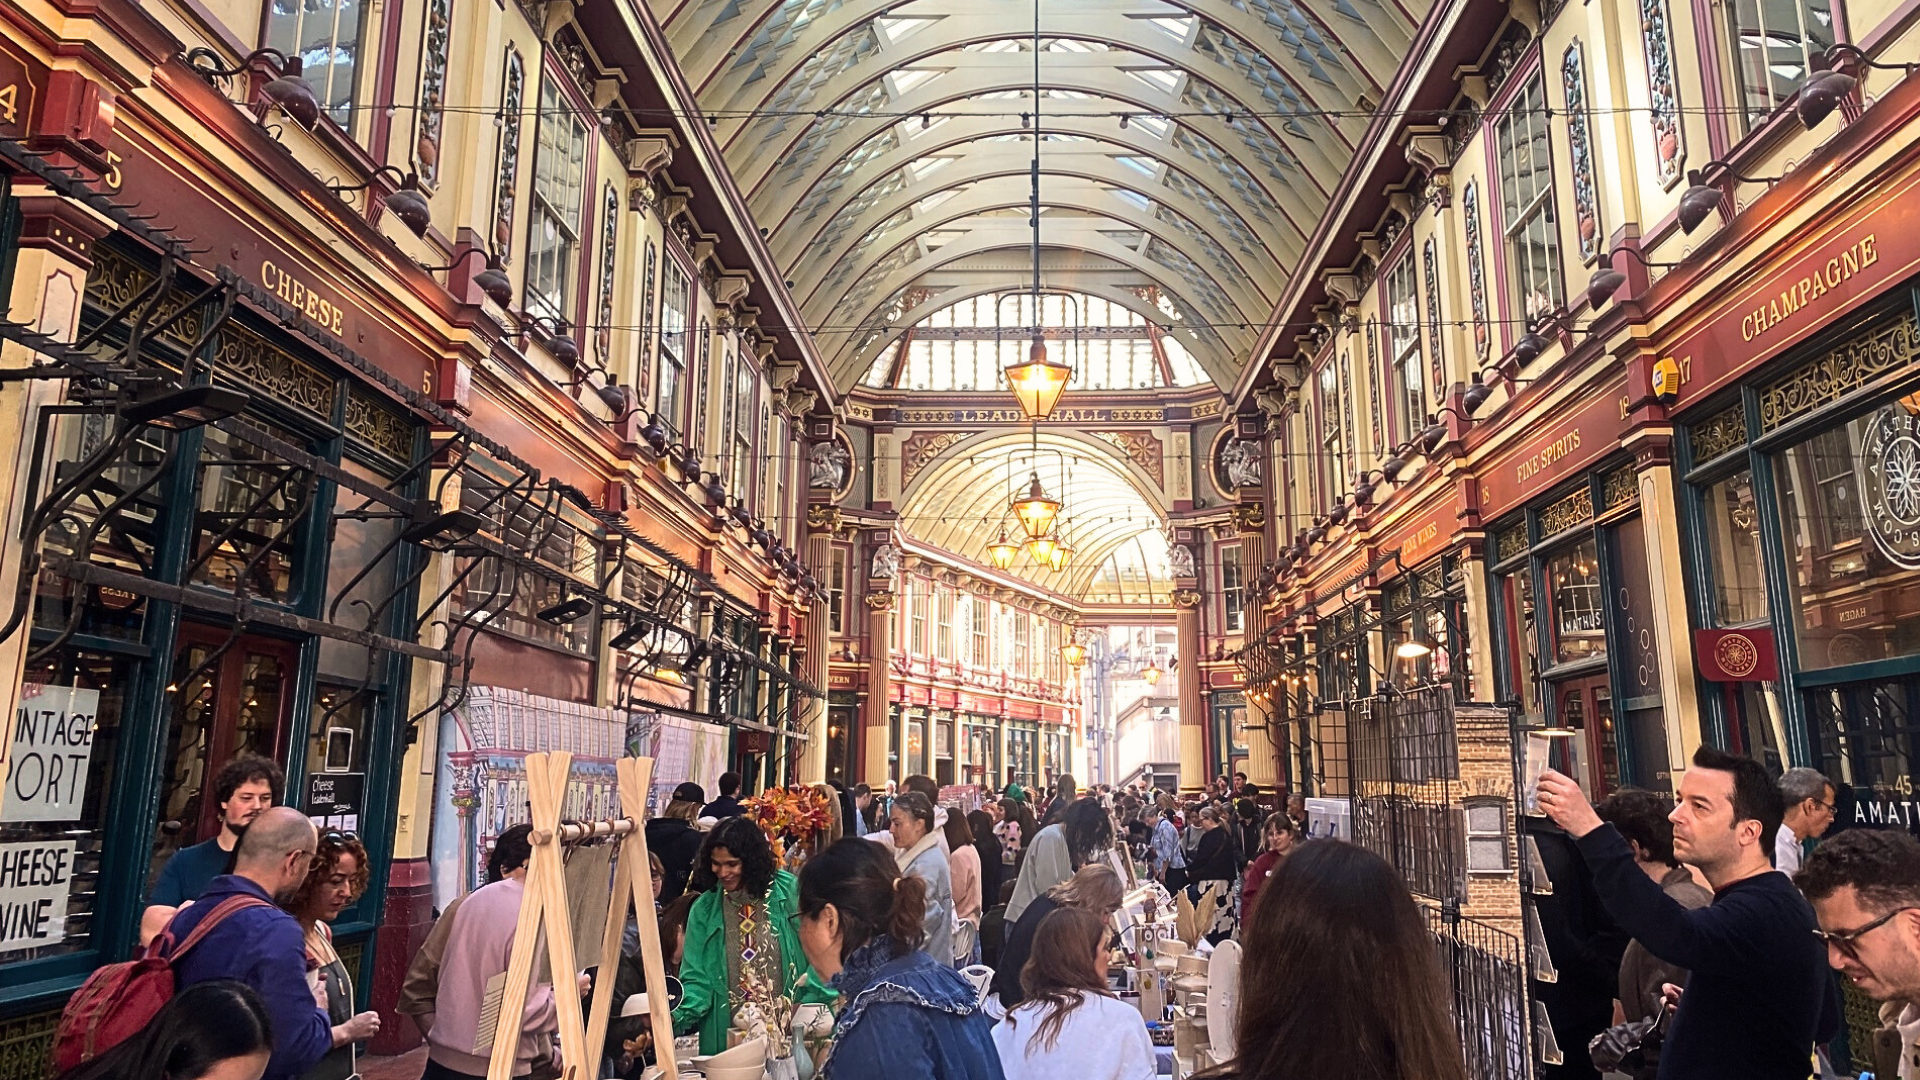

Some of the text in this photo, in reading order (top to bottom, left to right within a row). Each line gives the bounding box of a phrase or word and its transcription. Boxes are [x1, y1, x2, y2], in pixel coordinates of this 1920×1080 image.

[105, 150, 122, 189] 5
[261, 260, 344, 337] CHEESE
[1741, 233, 1878, 342] CHAMPAGNE
[422, 370, 432, 395] 5
[1678, 355, 1691, 386] 17
[961, 410, 1106, 422] LEADEHALL
[1516, 427, 1581, 485] FINE SPIRITS
[1481, 486, 1490, 506] 18
[1560, 611, 1601, 636] AMATHUS
[828, 675, 850, 684] VERN
[14, 707, 94, 747] INTAGE
[1894, 775, 1913, 795] 45
[0, 848, 68, 888] HEESE
